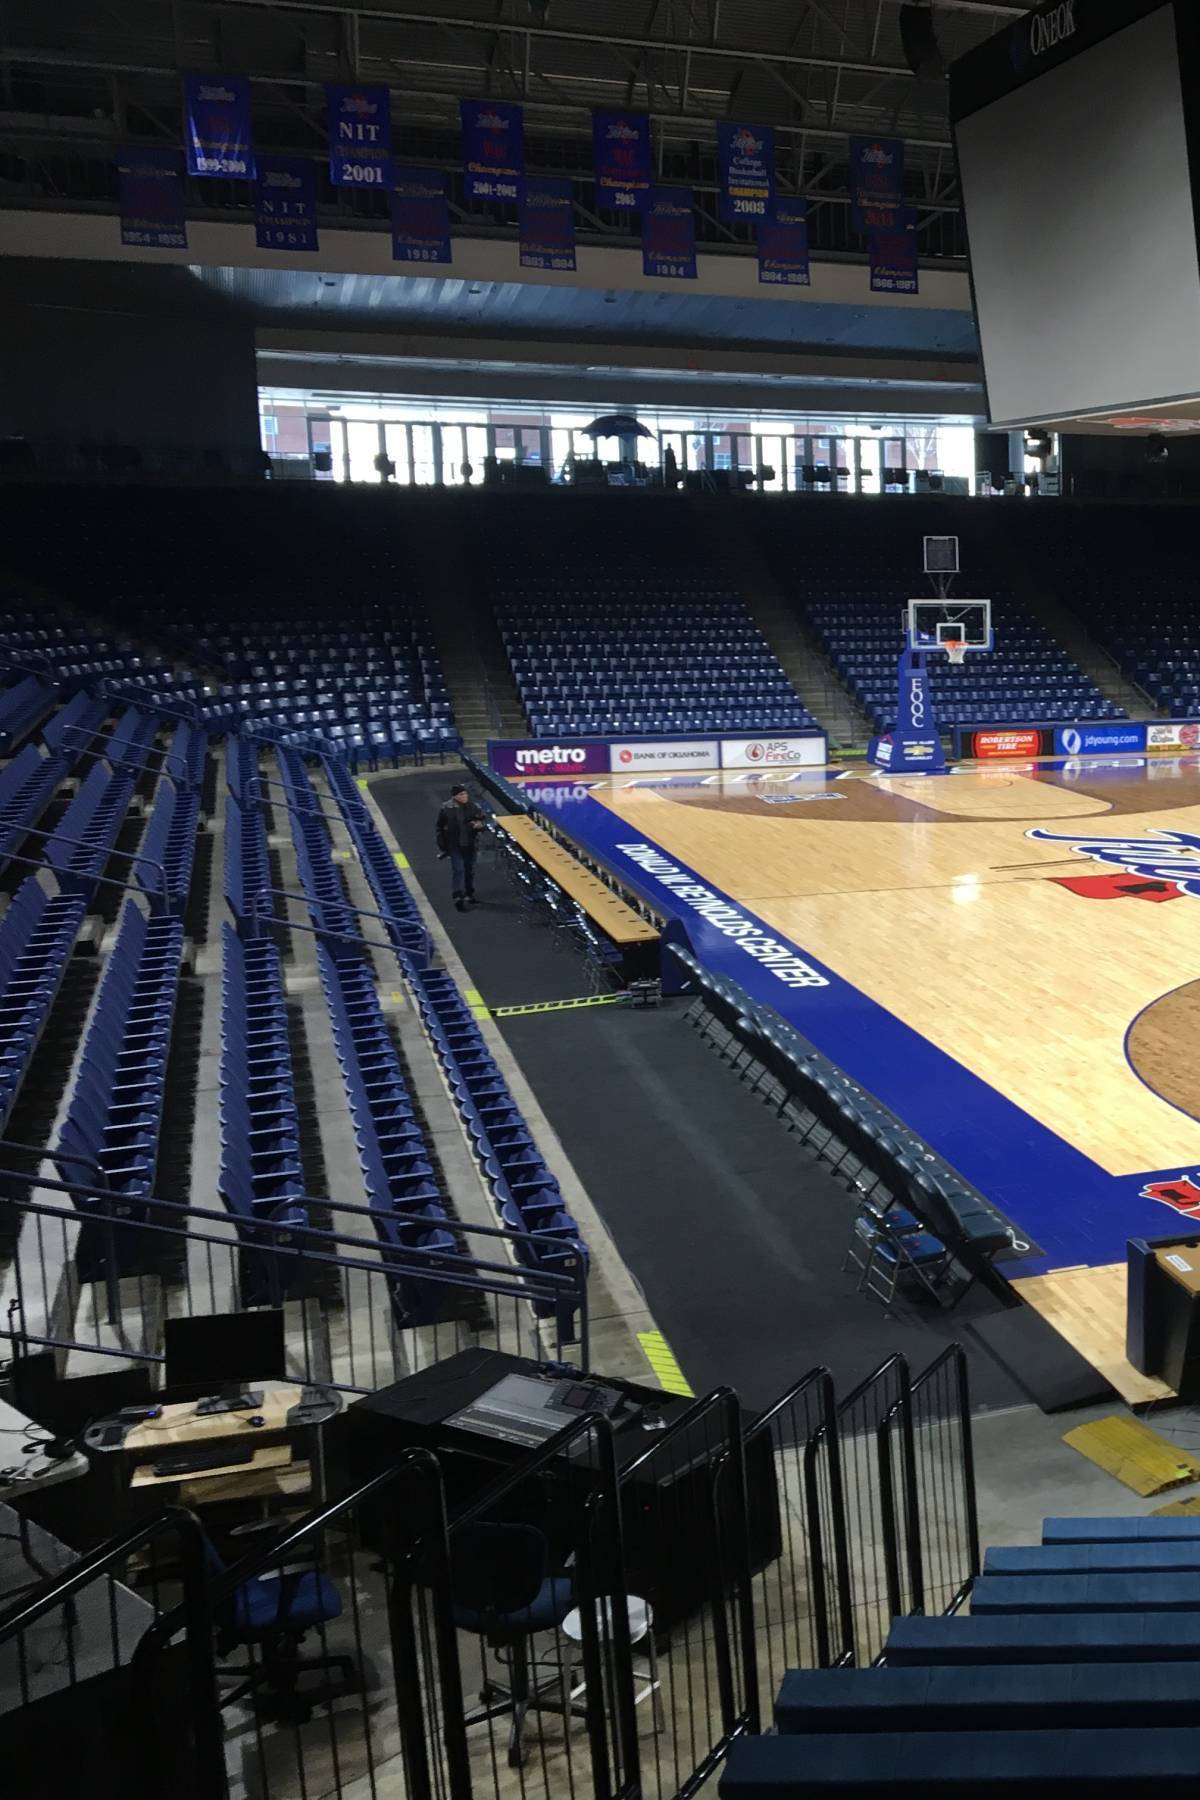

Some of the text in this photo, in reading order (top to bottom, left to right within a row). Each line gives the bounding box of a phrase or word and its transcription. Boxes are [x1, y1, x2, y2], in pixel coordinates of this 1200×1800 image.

[1030, 0, 1076, 56] ONEOK
[338, 121, 381, 142] NIT
[342, 164, 384, 183] 2001
[263, 199, 308, 214] NIT
[733, 199, 766, 215] 2008
[766, 742, 788, 752] APS
[980, 735, 1034, 744] ROBERTSON
[997, 743, 1018, 751] TIRE
[1085, 734, 1138, 748] jdyoung.com
[515, 746, 588, 766] metro
[633, 752, 656, 760] BANK
[668, 750, 710, 759] OKLAHOMA
[615, 843, 675, 877] DONALD
[668, 884, 763, 937] REYNOLDS
[735, 937, 830, 988] CENTER
